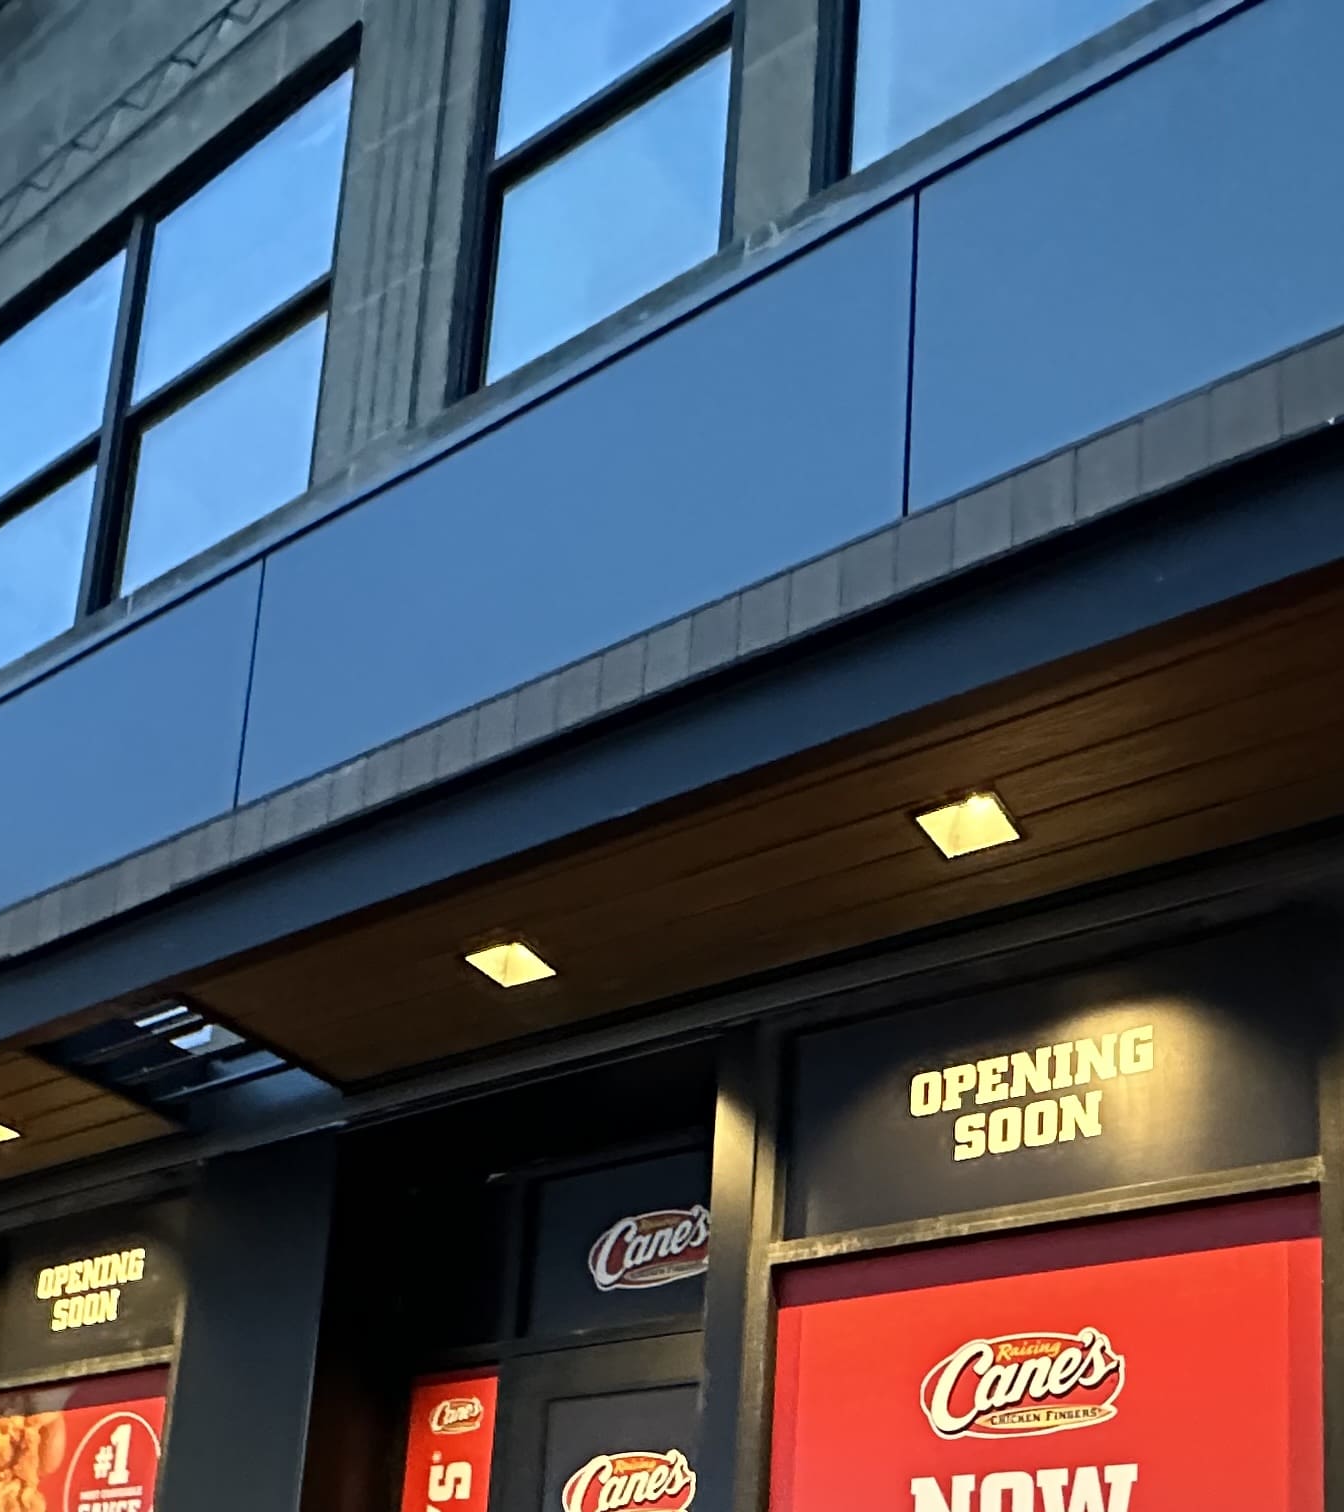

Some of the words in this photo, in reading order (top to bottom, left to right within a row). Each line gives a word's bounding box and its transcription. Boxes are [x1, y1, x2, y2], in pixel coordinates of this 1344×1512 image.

[910, 1025, 1154, 1118] OPENING
[953, 1090, 1103, 1162] SOON
[37, 1248, 146, 1299] OPENING
[51, 1288, 121, 1332] SOON
[931, 1331, 1120, 1432] Cane's
[996, 1340, 1062, 1363] Raising
[93, 1423, 132, 1485] #1
